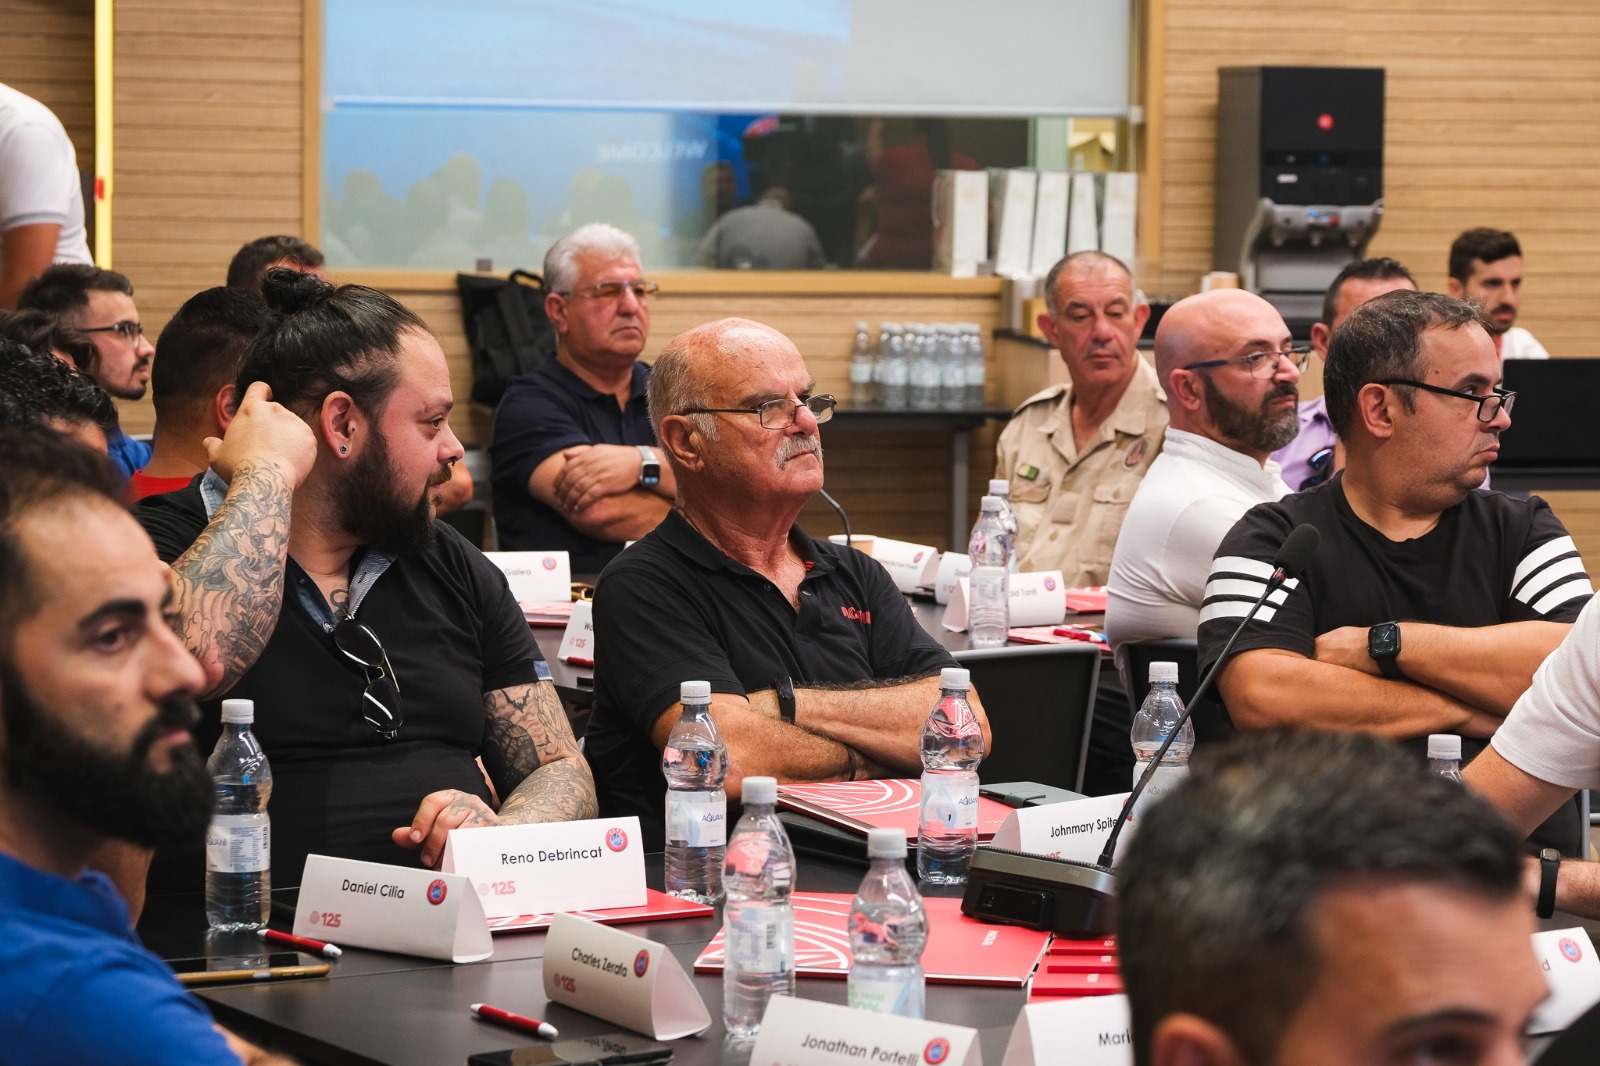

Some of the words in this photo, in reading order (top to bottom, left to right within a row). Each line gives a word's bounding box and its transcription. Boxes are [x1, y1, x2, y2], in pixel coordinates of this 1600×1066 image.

[504, 568, 531, 576] Galea
[1050, 822, 1094, 838] Johnmary
[1096, 817, 1118, 832] Spite
[501, 853, 534, 865] Reno
[538, 846, 602, 862] Debrincat
[342, 879, 378, 895] Daniel
[380, 884, 405, 899] Cilia
[490, 880, 516, 896] 125
[321, 912, 342, 928] 125
[572, 948, 601, 969] Charles
[602, 957, 628, 978] Zerafa
[561, 976, 576, 993] 125
[1098, 1029, 1132, 1046] Mari
[801, 1034, 867, 1058] Jonathan
[870, 1046, 920, 1066] Portelli
